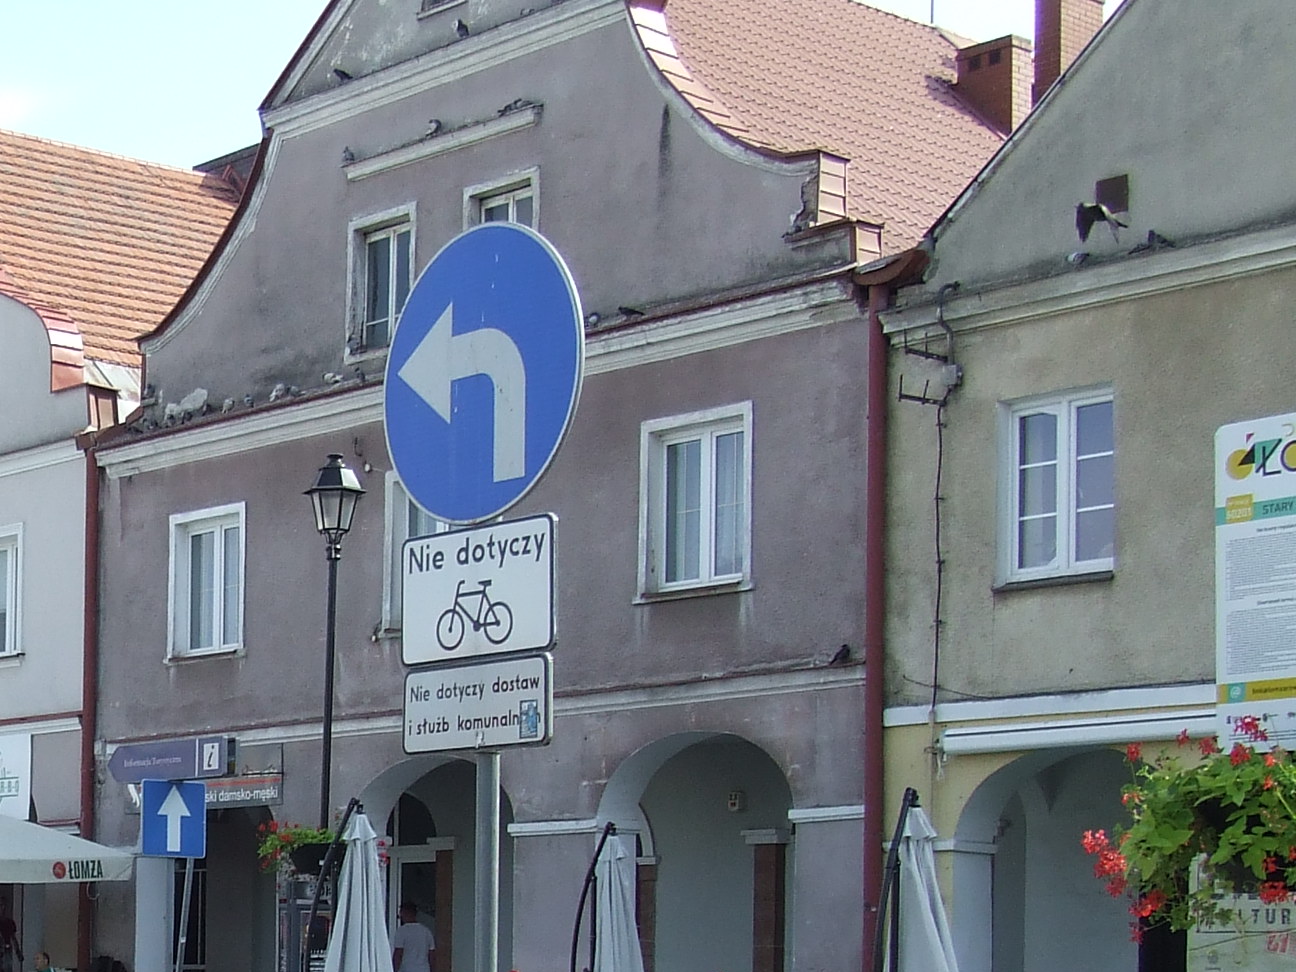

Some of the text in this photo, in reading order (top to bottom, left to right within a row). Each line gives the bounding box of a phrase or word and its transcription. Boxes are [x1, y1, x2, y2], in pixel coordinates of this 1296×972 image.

[1262, 501, 1293, 515] STARY
[408, 532, 546, 574] Nie dotyczy
[410, 674, 540, 703] Nie dotyczy dostaw
[408, 720, 413, 736] i
[416, 715, 450, 734] służb
[218, 786, 278, 802] damsko-męski
